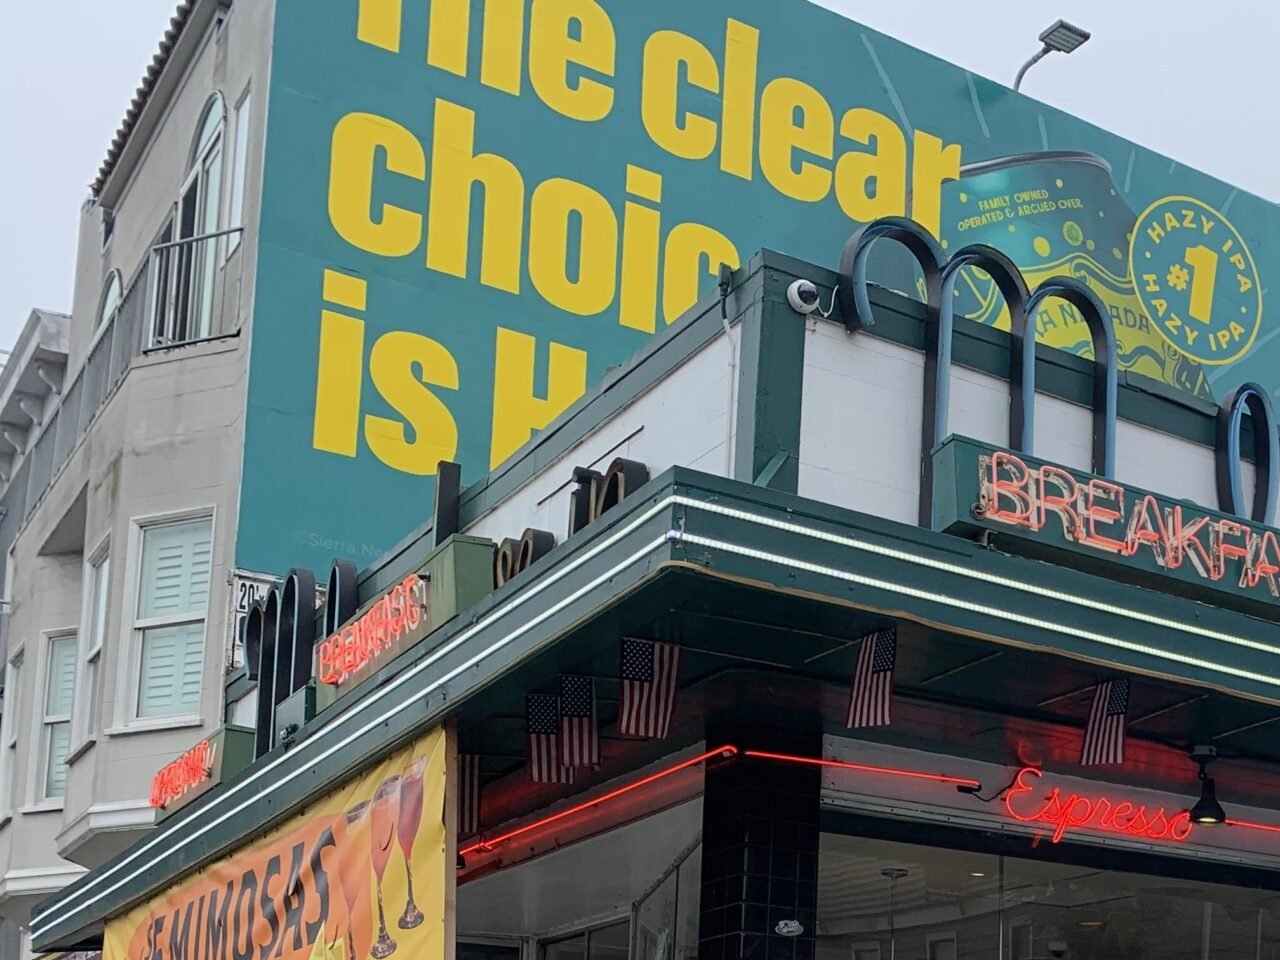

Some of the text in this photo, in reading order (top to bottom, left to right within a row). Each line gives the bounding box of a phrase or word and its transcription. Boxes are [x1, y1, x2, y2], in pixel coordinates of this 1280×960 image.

[641, 18, 962, 246] clear
[328, 98, 740, 334] choic
[957, 210, 1004, 232] OPERATED
[1018, 201, 1057, 217] ARGUED
[978, 189, 1049, 211] FAMILY OWNED
[1146, 209, 1215, 244] HAZY
[1166, 244, 1218, 325] #1
[1220, 239, 1252, 293] IPA
[1142, 273, 1199, 346] HAZY
[1208, 320, 1247, 351] IPA
[312, 268, 459, 476] is
[1005, 767, 1193, 843] Espresso
